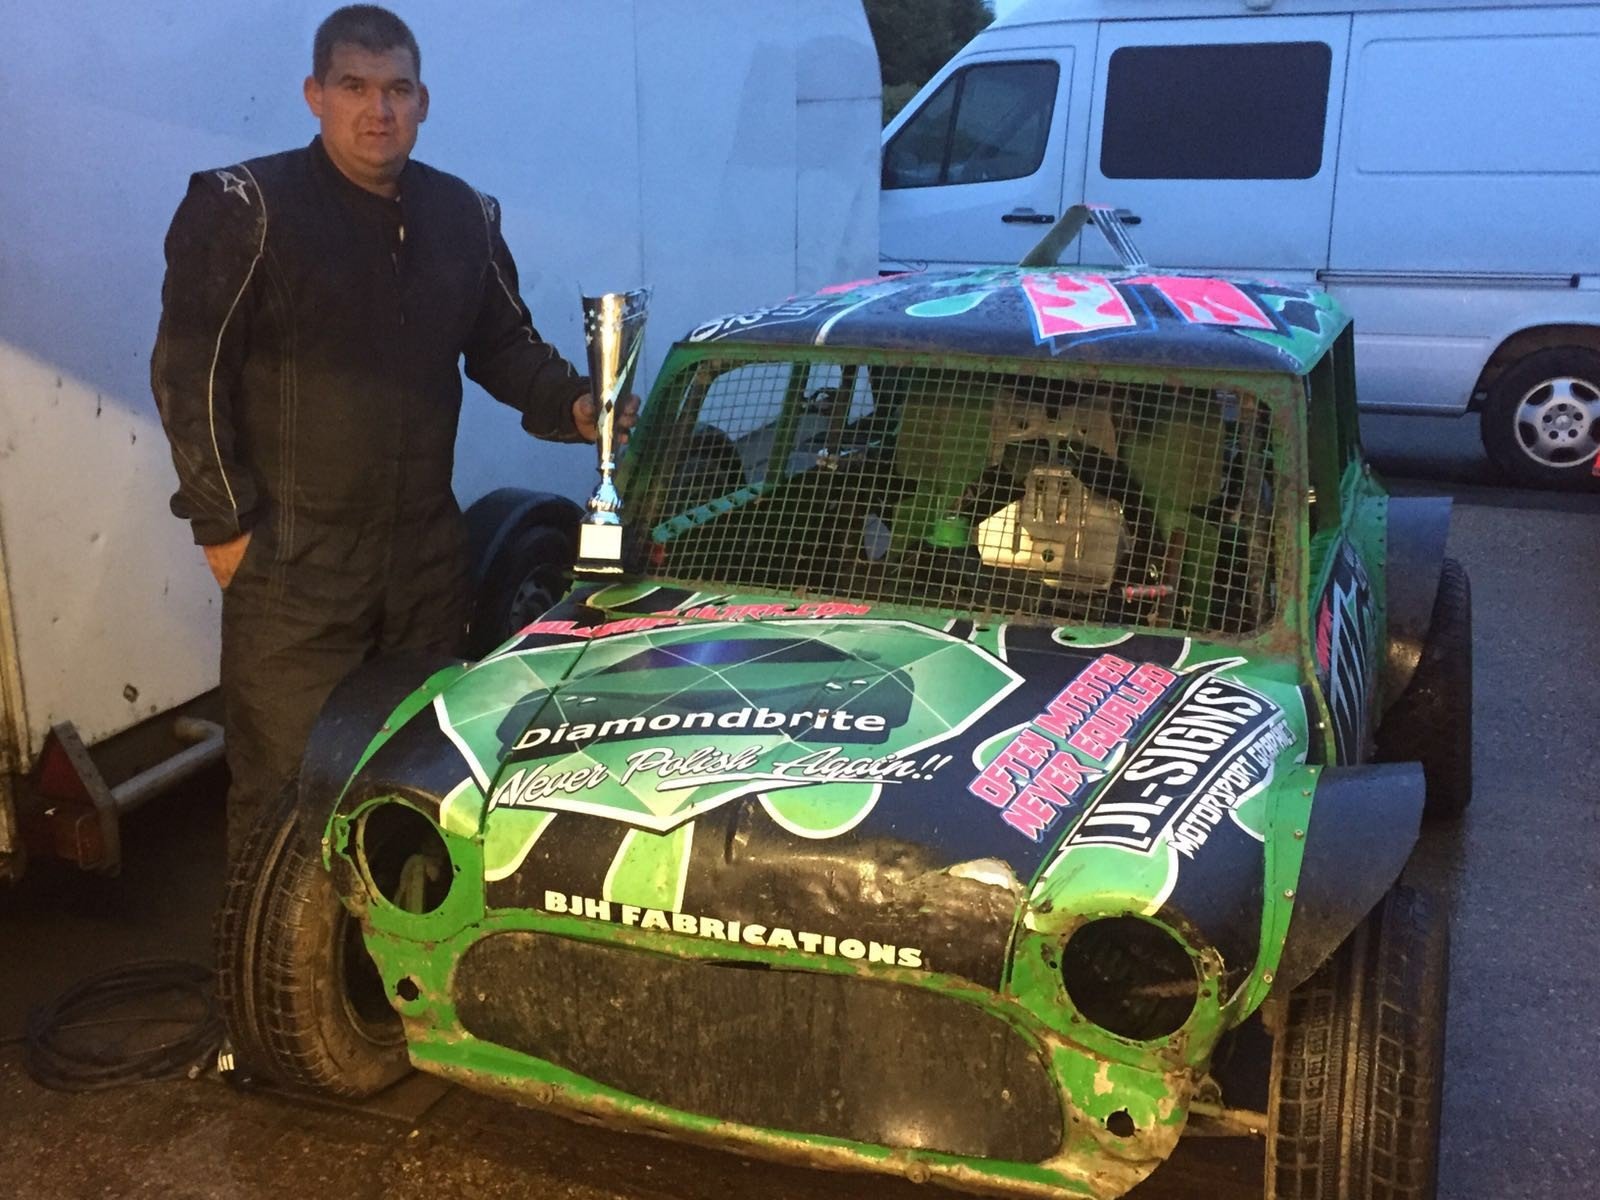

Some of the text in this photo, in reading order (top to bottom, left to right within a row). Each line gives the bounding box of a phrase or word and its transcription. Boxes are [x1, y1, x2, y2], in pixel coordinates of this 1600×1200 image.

[487, 744, 953, 813] Never Polish Again!!
[511, 706, 888, 751] Diamondbrite
[967, 653, 1137, 808] OFTEN IMITATED
[1000, 662, 1179, 842] NEVER EQUALLED
[1166, 718, 1298, 861] MOTORSPORT GRAPHICS
[544, 889, 923, 969] BJH FABRICATIONS
